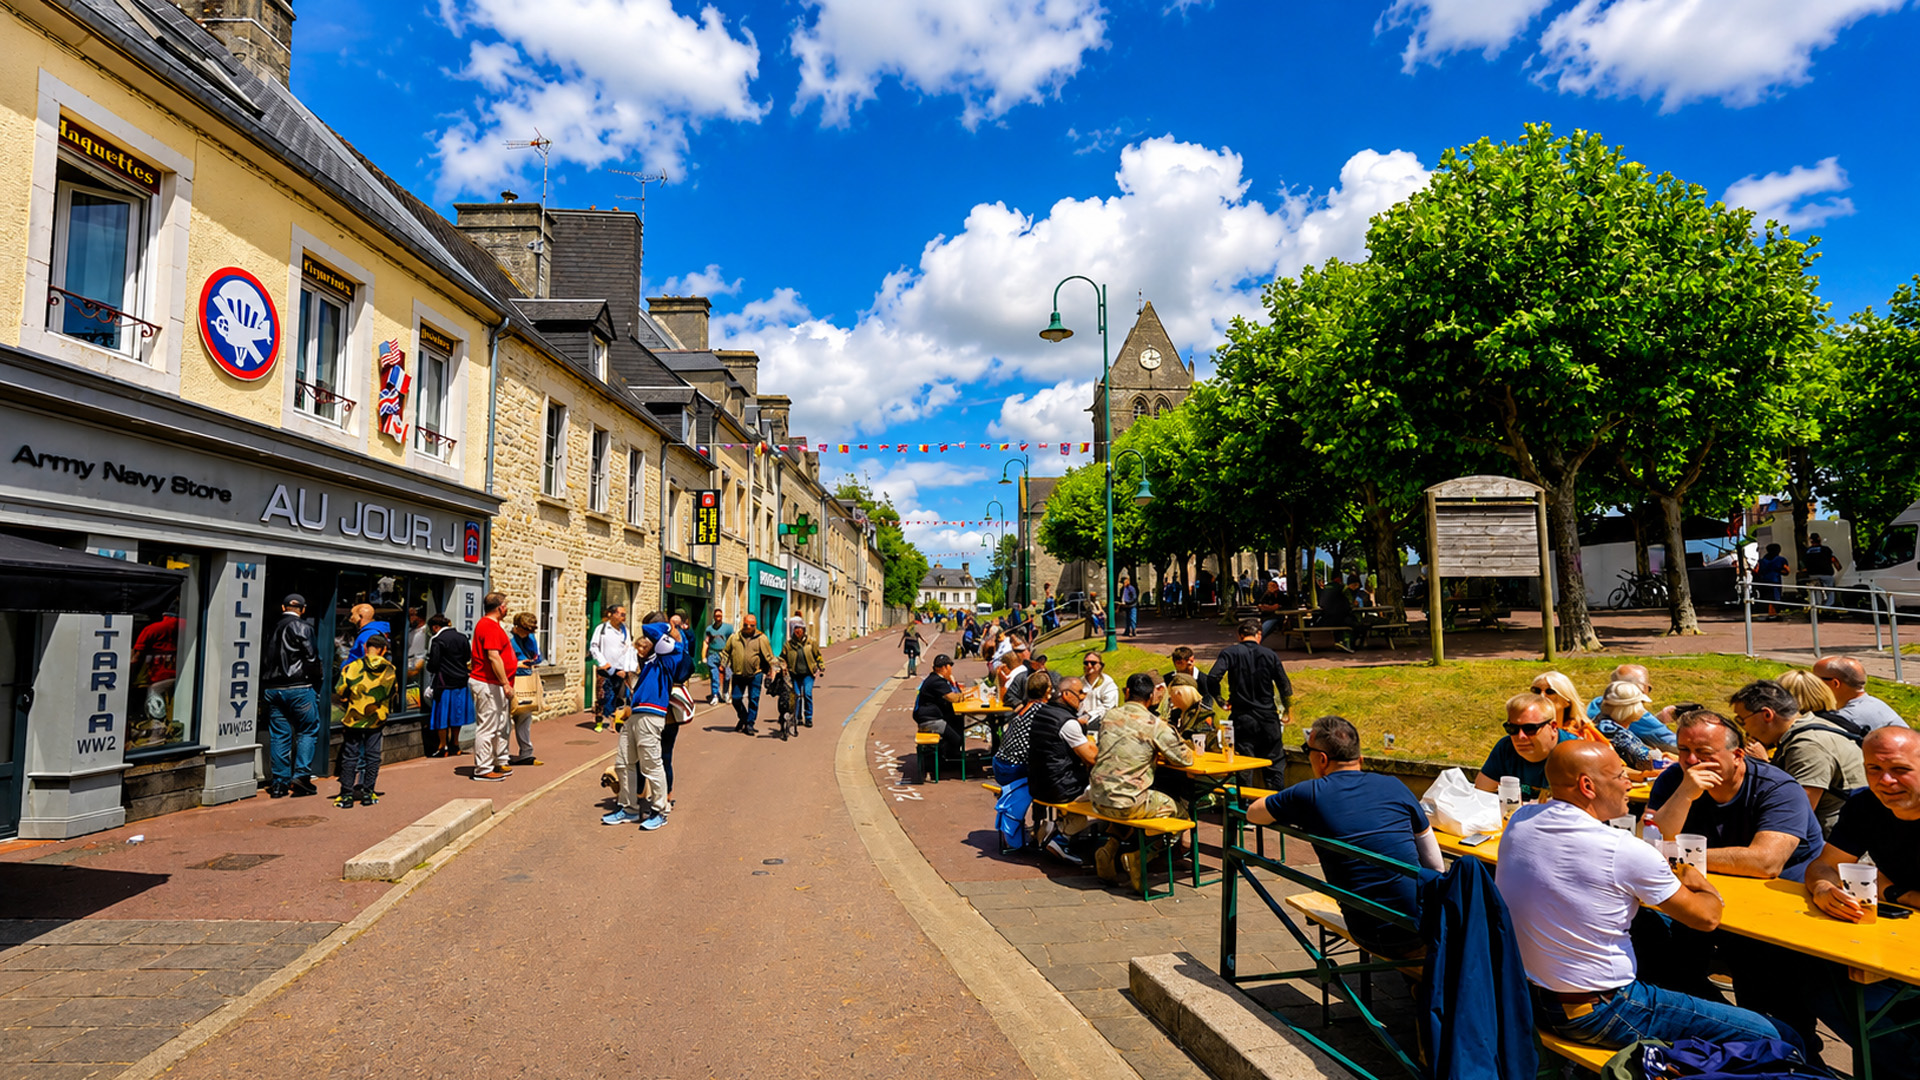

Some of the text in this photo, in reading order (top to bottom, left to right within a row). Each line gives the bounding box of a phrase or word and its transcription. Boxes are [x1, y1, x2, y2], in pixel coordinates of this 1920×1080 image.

[12, 445, 232, 503] Army Navy Store
[260, 484, 457, 553] AU JOUR J
[230, 562, 257, 718] MILITARY
[77, 735, 116, 754] WW2
